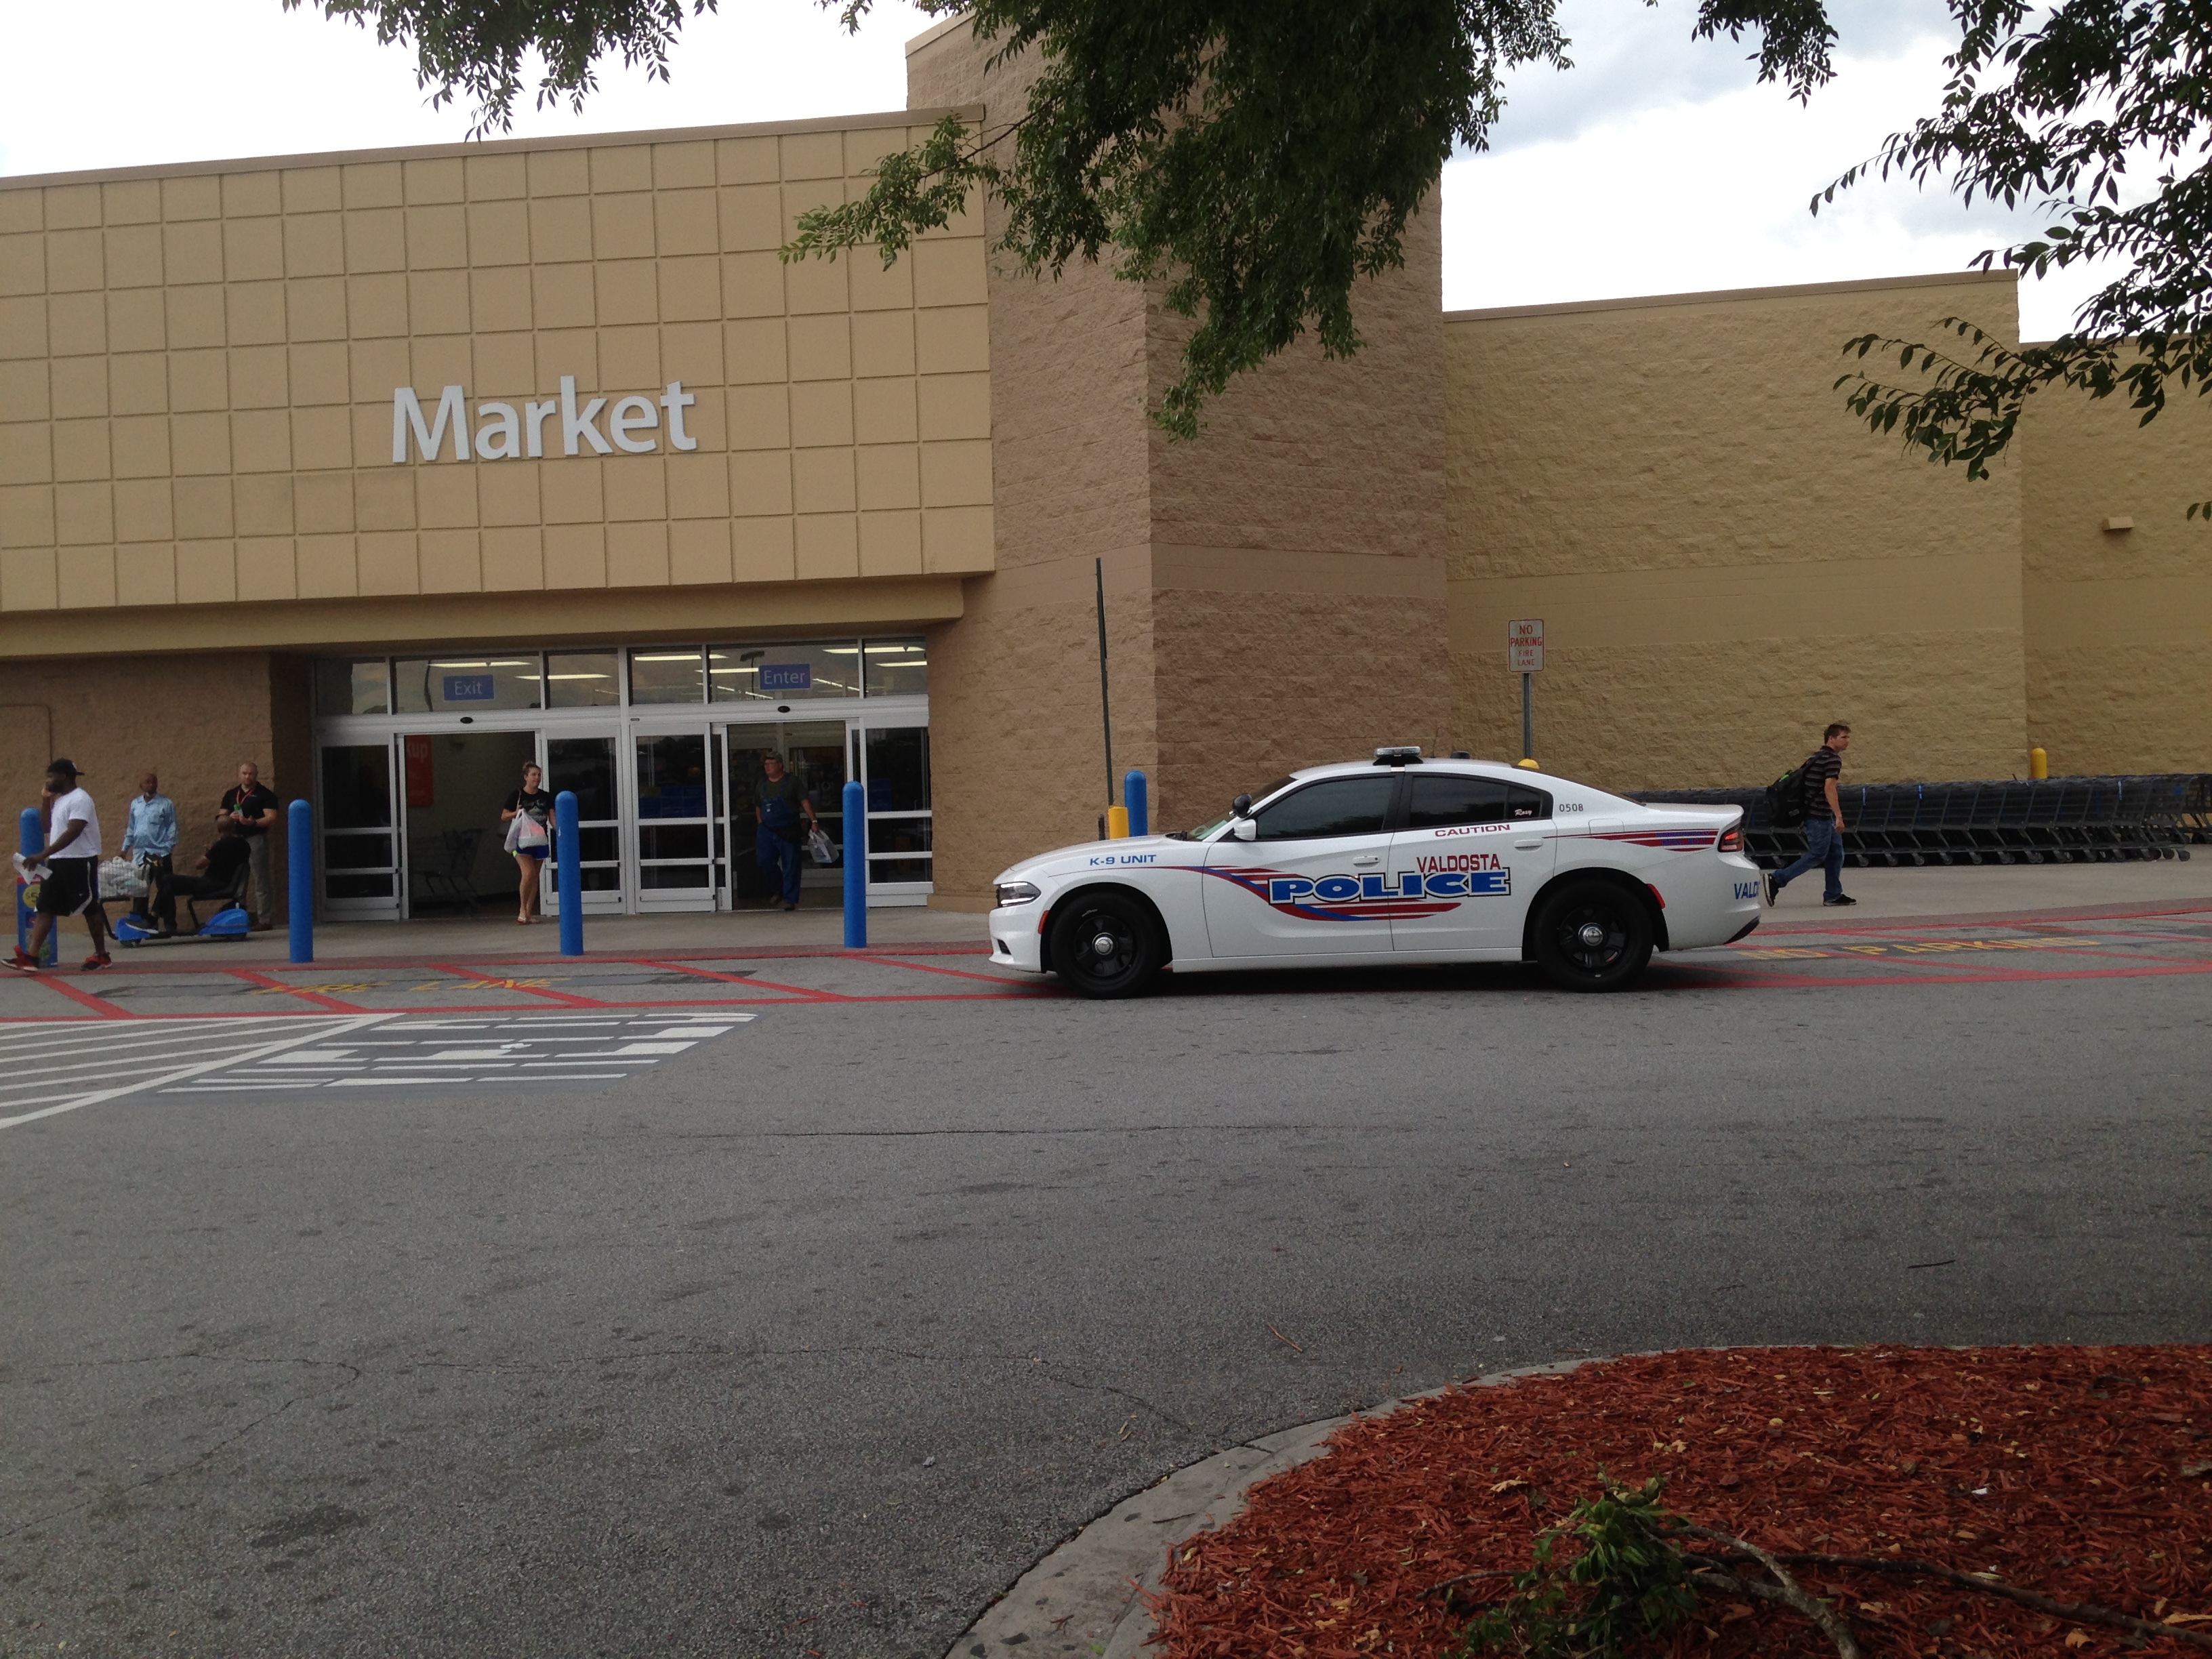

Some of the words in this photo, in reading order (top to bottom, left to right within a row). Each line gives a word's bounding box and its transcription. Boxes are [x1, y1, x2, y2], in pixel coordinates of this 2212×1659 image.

[393, 375, 697, 464] Market
[1519, 625, 1533, 634] NO
[1511, 637, 1542, 647] PARKING
[764, 670, 805, 684] Enter
[455, 680, 483, 695] Exit
[1559, 804, 1584, 812] 0508
[1435, 824, 1511, 837] CAUTION
[1090, 857, 1115, 865] K-9
[1121, 855, 1156, 863] UNIT
[1416, 853, 1502, 873] VALDOSTA
[1269, 867, 1511, 905] POLICE
